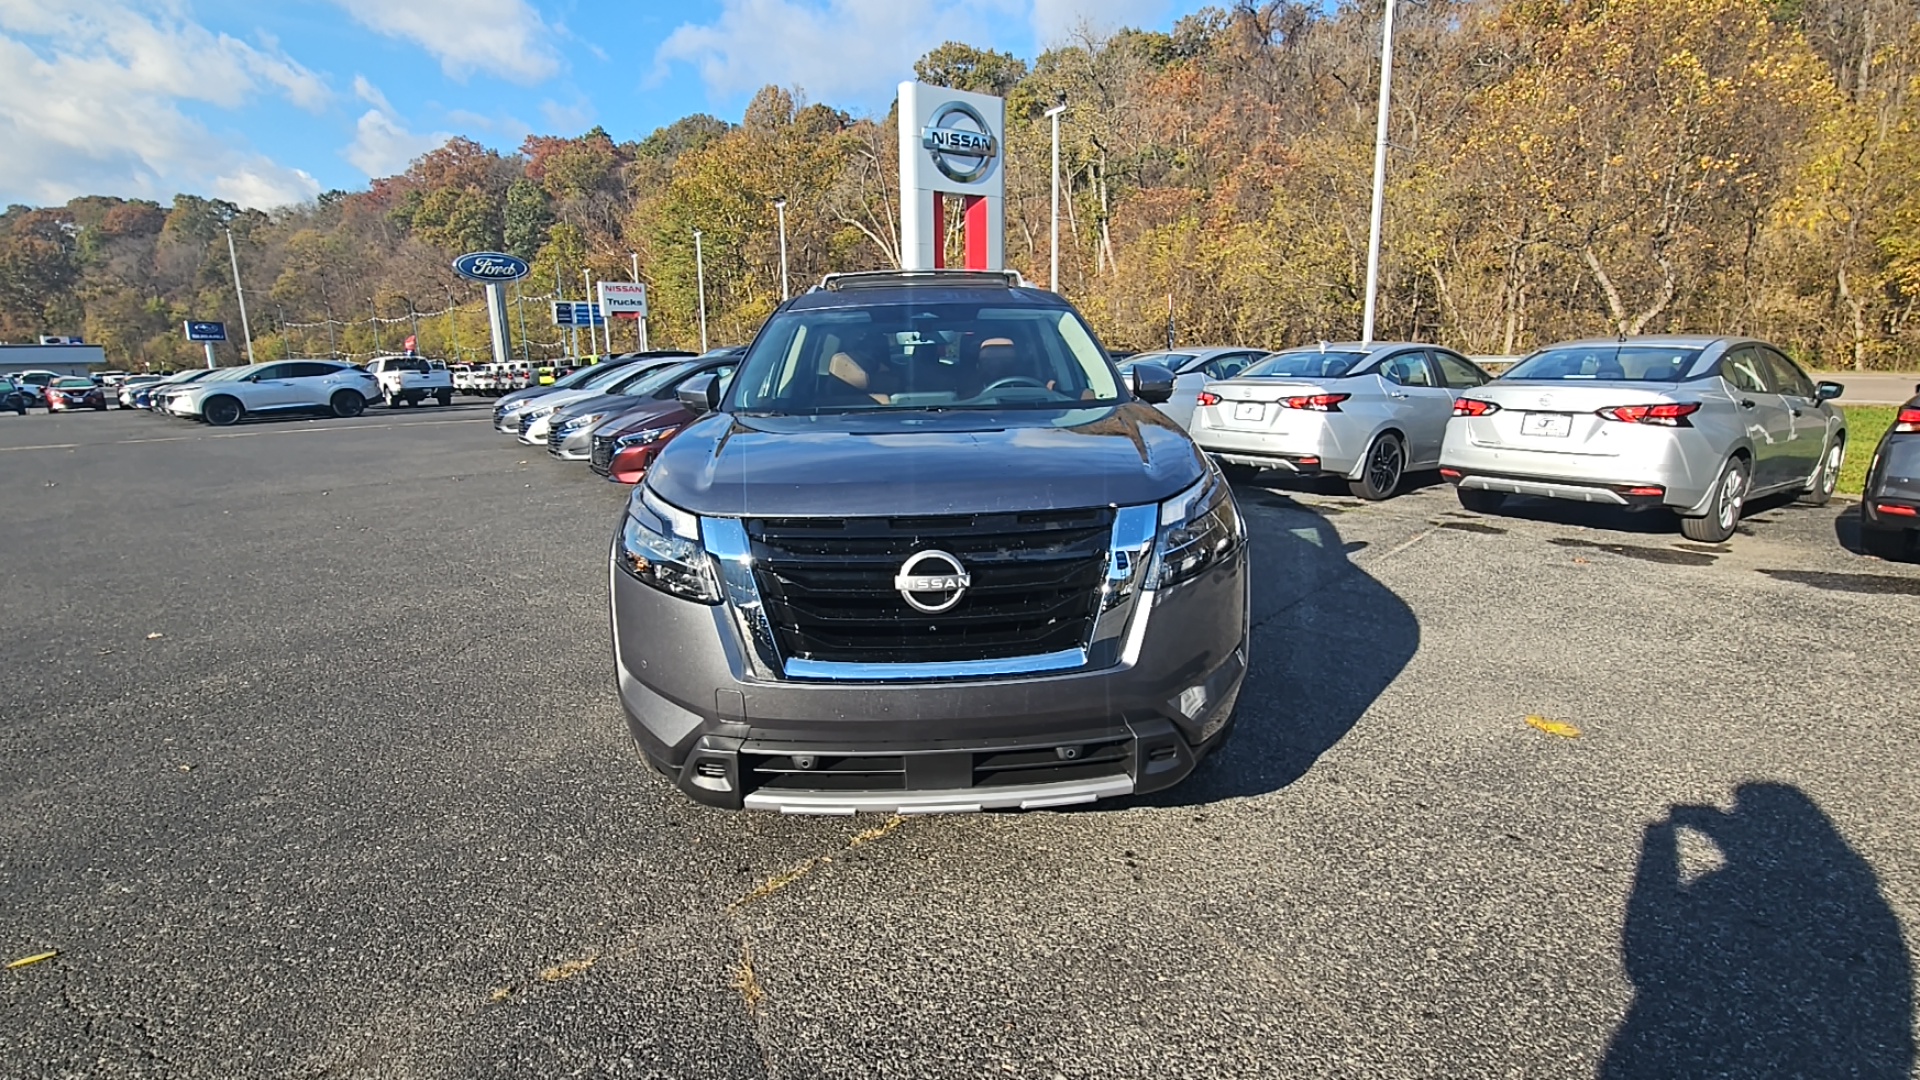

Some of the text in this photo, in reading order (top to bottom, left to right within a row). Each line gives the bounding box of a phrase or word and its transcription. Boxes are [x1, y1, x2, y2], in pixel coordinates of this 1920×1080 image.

[932, 132, 991, 151] NISSAN
[472, 257, 516, 275] Ford
[605, 285, 642, 293] NISSAN
[607, 298, 643, 306] Trucks
[898, 577, 971, 590] NISSAN
